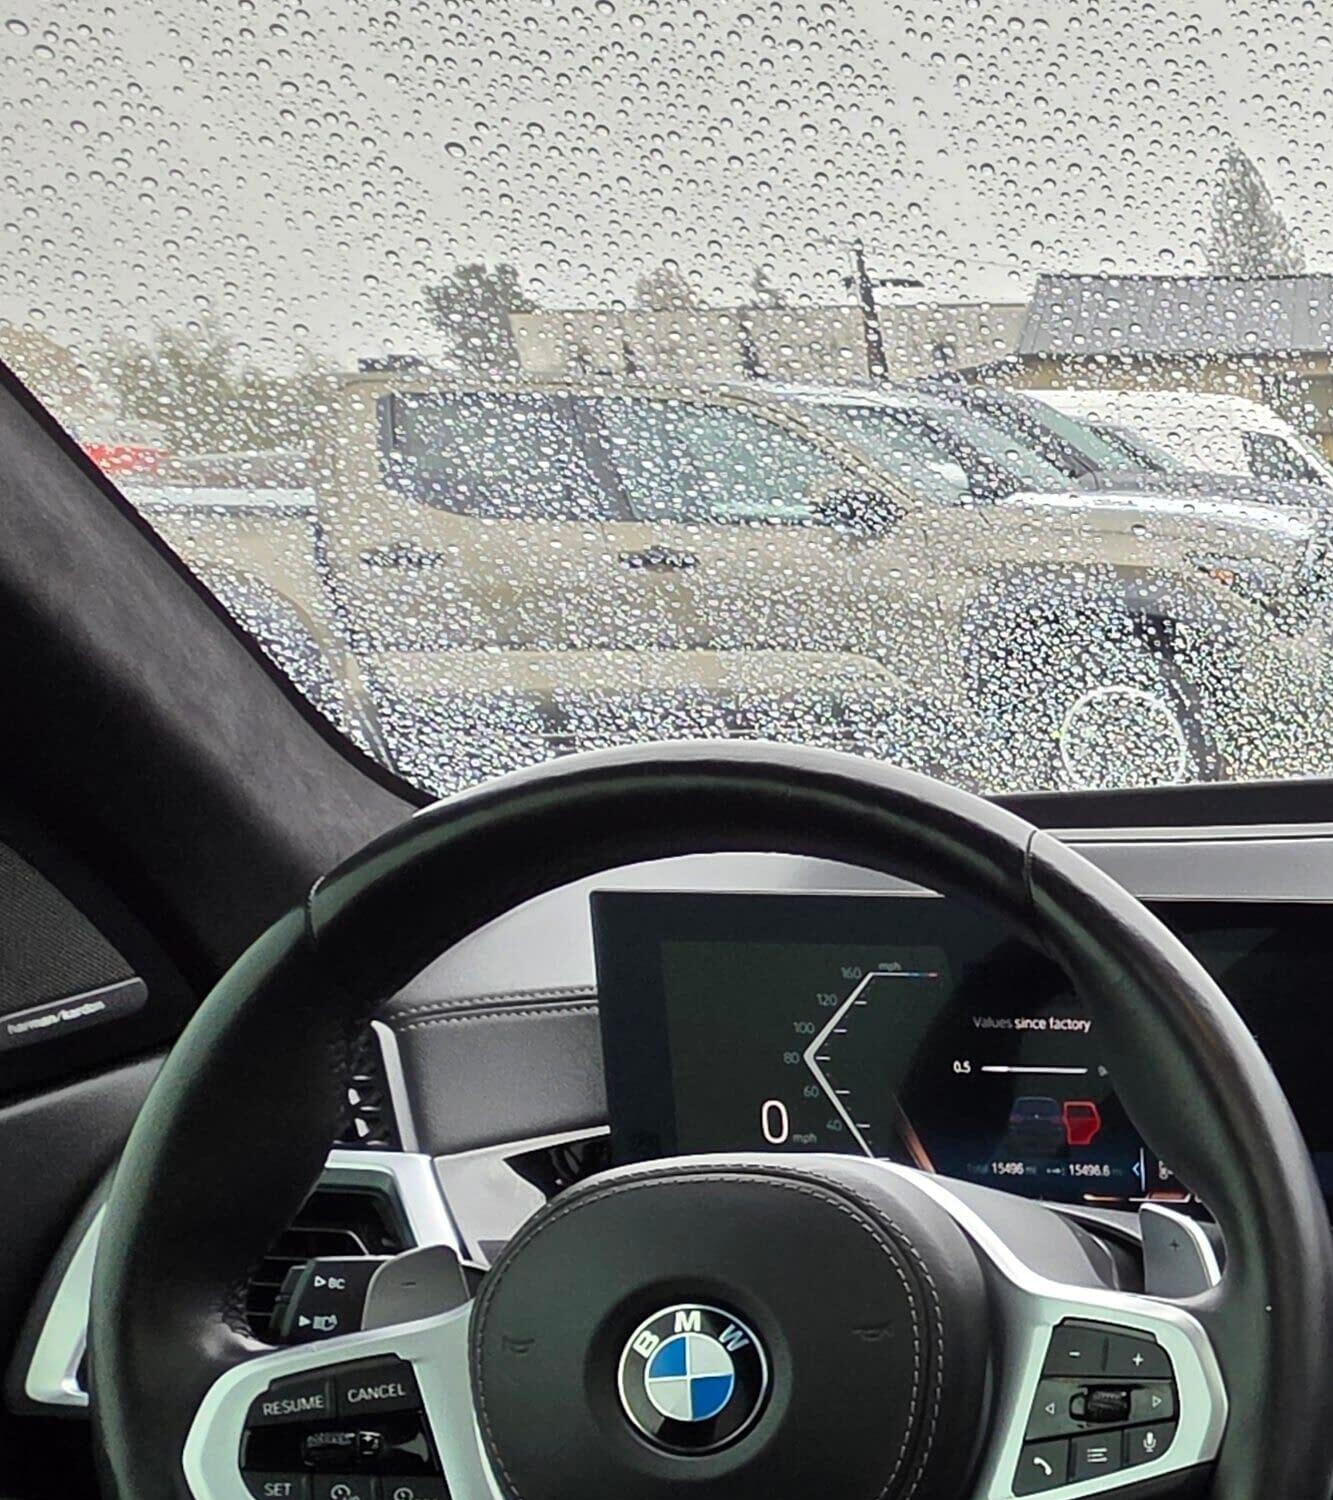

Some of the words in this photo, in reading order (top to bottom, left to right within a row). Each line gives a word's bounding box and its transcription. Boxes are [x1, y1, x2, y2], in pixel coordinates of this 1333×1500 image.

[841, 966, 862, 980] 160
[816, 993, 838, 1007] 120
[793, 1021, 815, 1035] 100
[972, 1016, 1013, 1030] Values
[1014, 1017, 1047, 1030] since
[1048, 1016, 1092, 1033] factory
[783, 1051, 800, 1064] 80
[803, 1085, 820, 1098] 60
[761, 1099, 789, 1144] 0
[632, 1309, 750, 1360] BMW
[347, 1382, 406, 1404] CANCEL
[262, 1394, 325, 1417] RESUME
[264, 1482, 292, 1497] SET
